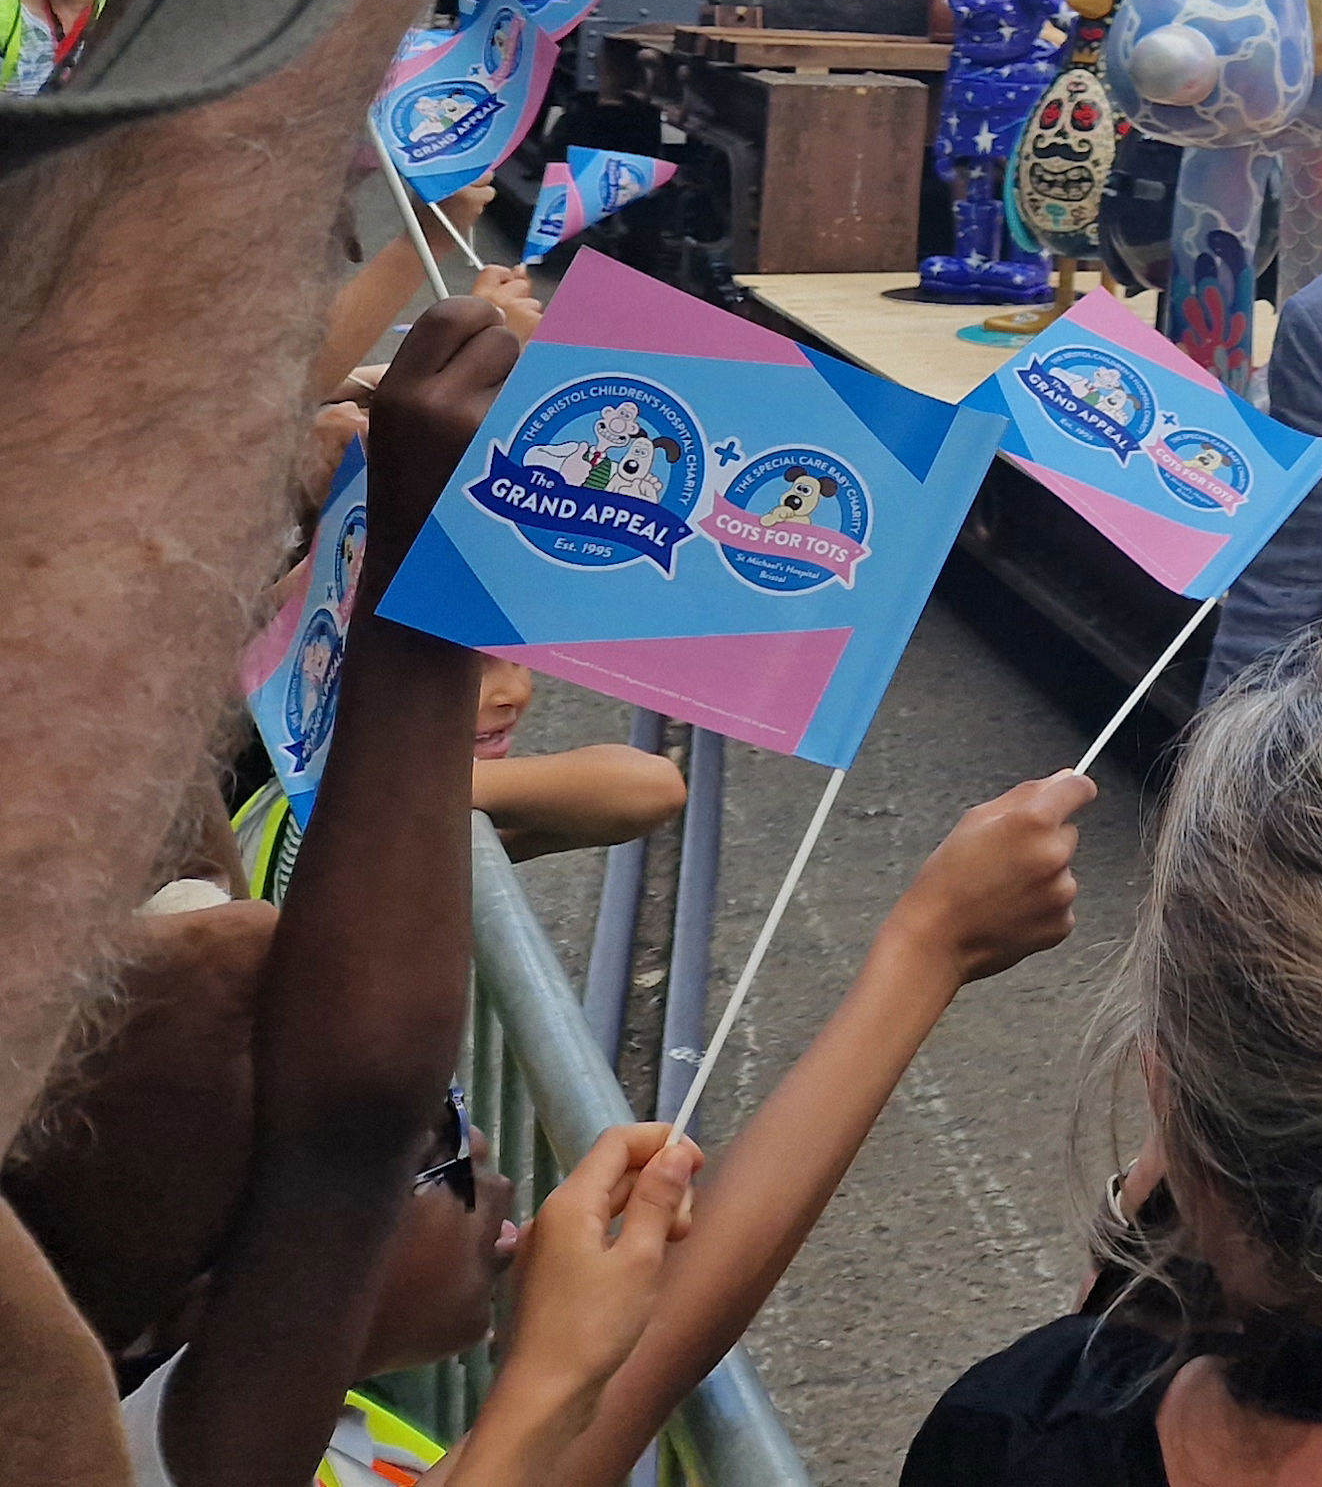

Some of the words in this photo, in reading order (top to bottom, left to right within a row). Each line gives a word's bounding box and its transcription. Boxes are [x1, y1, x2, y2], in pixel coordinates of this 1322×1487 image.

[412, 133, 459, 158] GRAND
[456, 101, 498, 136] APPEAL
[1028, 373, 1078, 412] GRAND
[1077, 410, 1128, 450] APPEAL
[521, 419, 545, 443] THE
[542, 388, 588, 422] BRISTOL
[589, 385, 661, 409] CHILDREN'S
[658, 404, 696, 454] HOSPITAL
[678, 455, 698, 506] CHARITY
[529, 470, 555, 490] The
[735, 475, 754, 494] THE
[752, 456, 797, 478] SPECIAL
[799, 456, 828, 472] CARE
[828, 466, 852, 489] BABY
[846, 487, 863, 534] CHARITY
[1156, 448, 1183, 471] COTS
[1183, 468, 1207, 485] FOR
[1207, 481, 1234, 502] TOTS
[490, 477, 577, 519] GRAND
[580, 502, 672, 547] APPEAL
[715, 514, 762, 542] COTS
[764, 529, 803, 548] FOR
[806, 536, 850, 563] TOTS
[554, 536, 577, 553] Est.
[581, 541, 614, 558] 1995
[746, 556, 785, 572] Michael's
[785, 564, 821, 580] Hospital
[759, 570, 787, 583] Bristol
